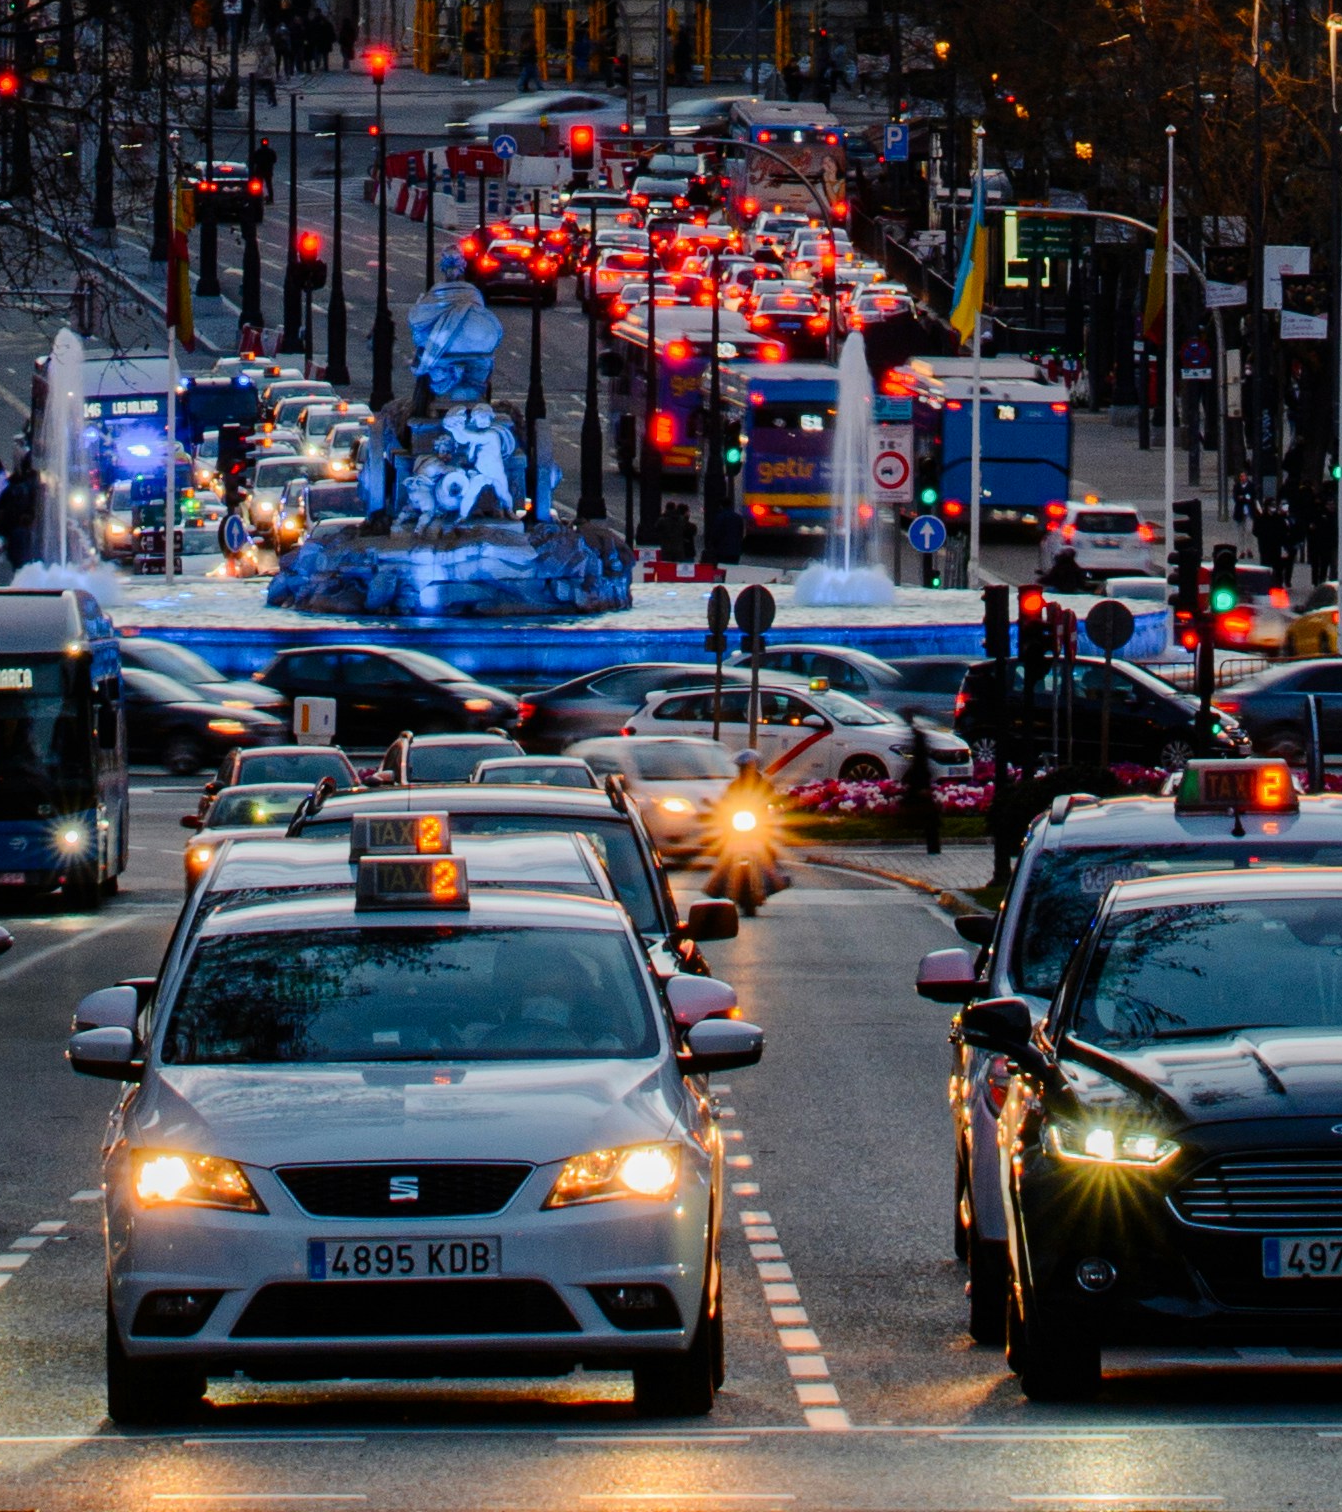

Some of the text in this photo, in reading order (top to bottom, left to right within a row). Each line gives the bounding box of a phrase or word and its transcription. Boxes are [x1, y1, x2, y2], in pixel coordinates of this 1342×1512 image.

[887, 126, 902, 150] P
[757, 456, 815, 484] getir
[1261, 767, 1281, 802] 2
[418, 815, 443, 852] 2
[433, 859, 458, 899] 2
[332, 1241, 491, 1276] 4895 KDB
